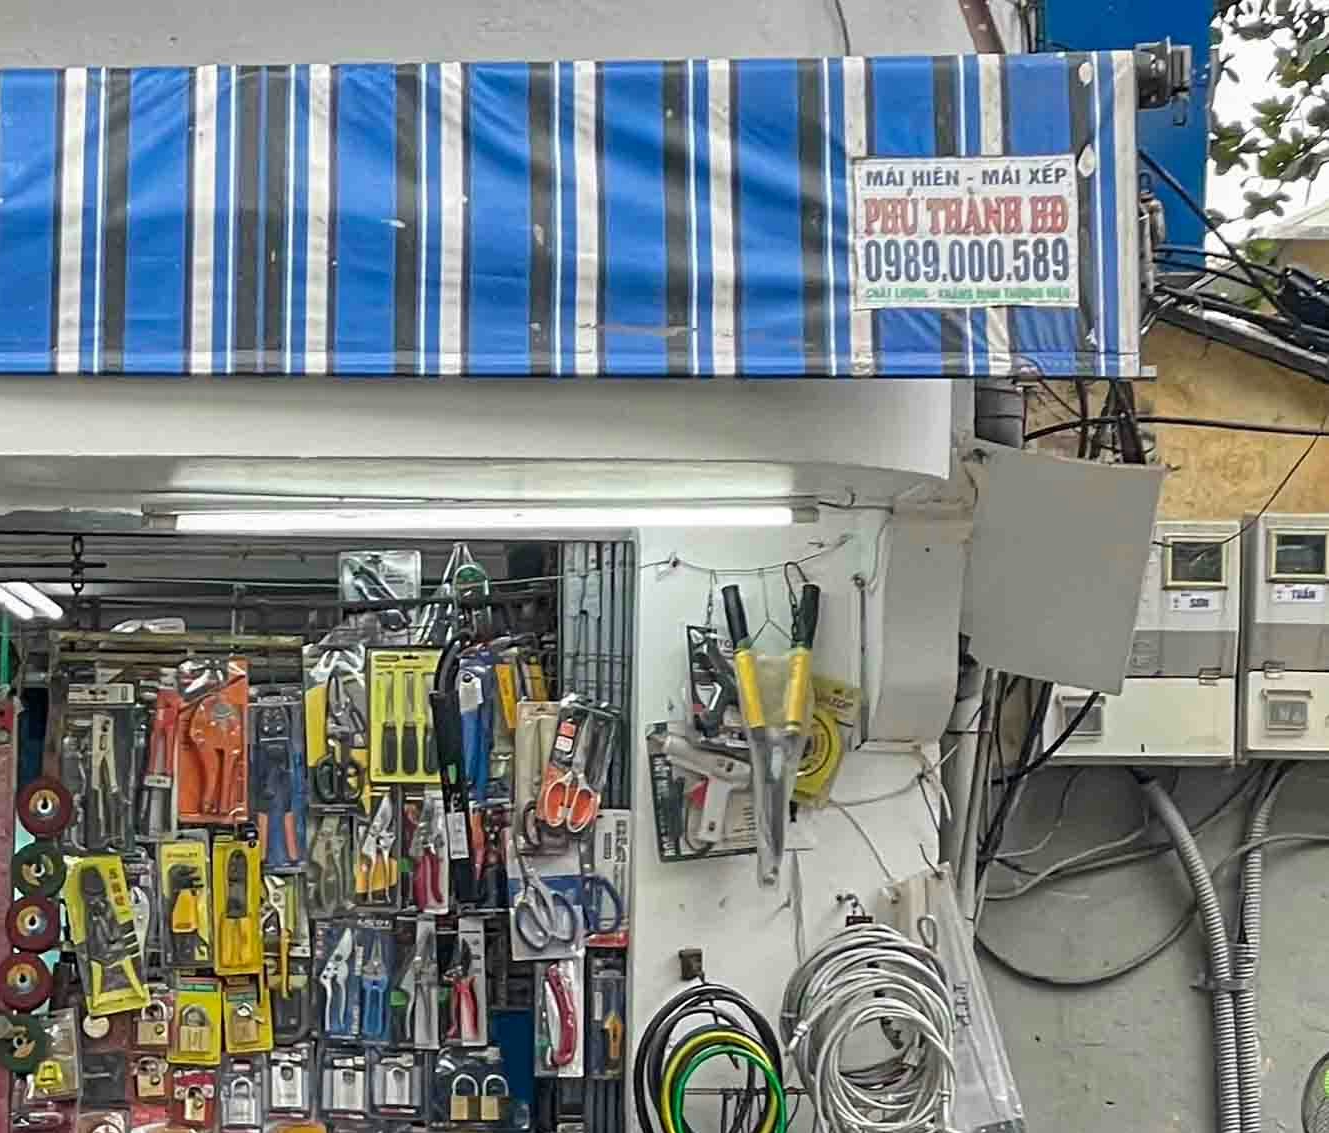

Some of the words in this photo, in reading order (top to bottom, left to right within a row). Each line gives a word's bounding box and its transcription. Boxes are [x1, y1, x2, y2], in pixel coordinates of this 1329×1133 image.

[866, 166, 903, 187] MÁI
[912, 165, 959, 186] HIÊN
[982, 165, 1020, 185] MÁI
[1029, 162, 1067, 184] XẾP
[926, 186, 1023, 235] THÀNH
[864, 238, 1070, 283] 0989.000.589
